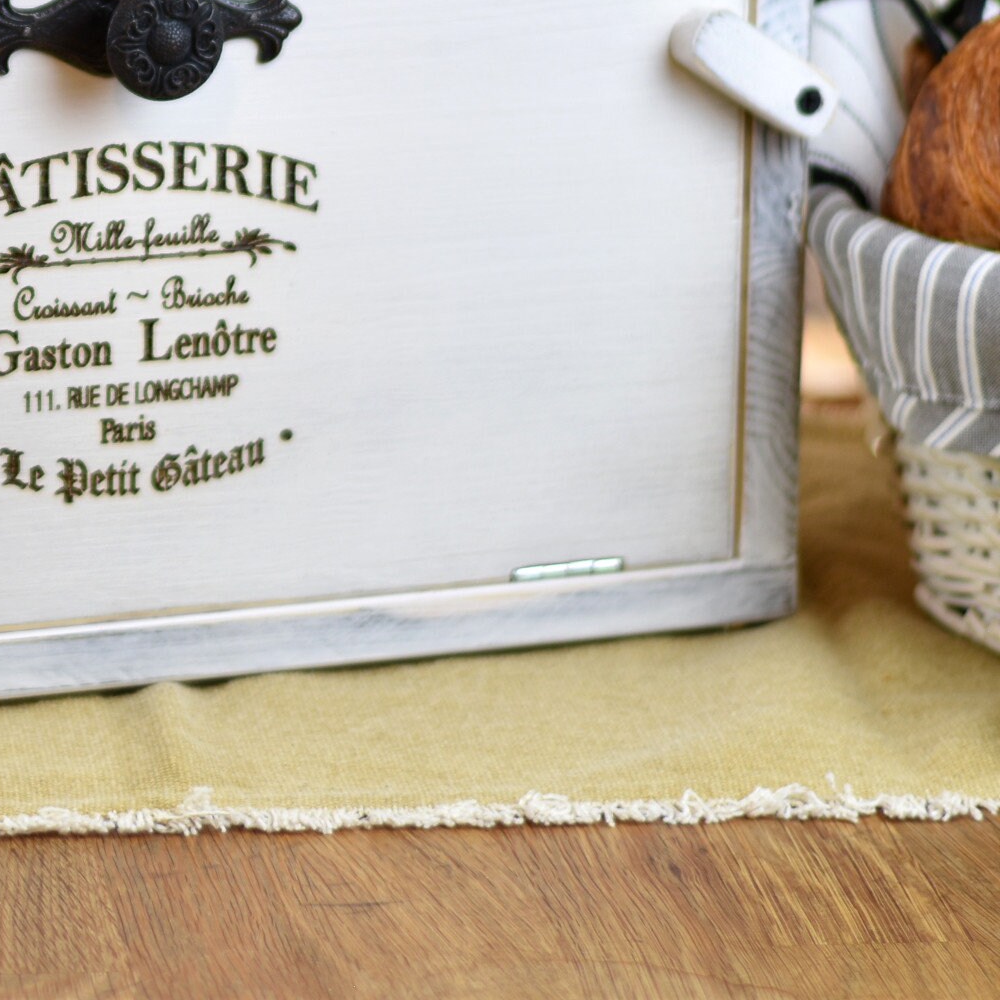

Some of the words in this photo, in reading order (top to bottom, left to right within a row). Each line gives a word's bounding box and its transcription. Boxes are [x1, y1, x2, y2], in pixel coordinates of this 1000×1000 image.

[13, 285, 118, 322] Croissant
[161, 274, 251, 310] Brioche
[138, 317, 278, 362] Lenôtre
[22, 389, 61, 413] 111.
[66, 382, 101, 410] RUE
[105, 381, 130, 407] DE
[133, 373, 240, 405] LONGCHAMP
[99, 414, 157, 445] Paris
[54, 456, 141, 504] Petit
[150, 436, 267, 493] Gâteau
